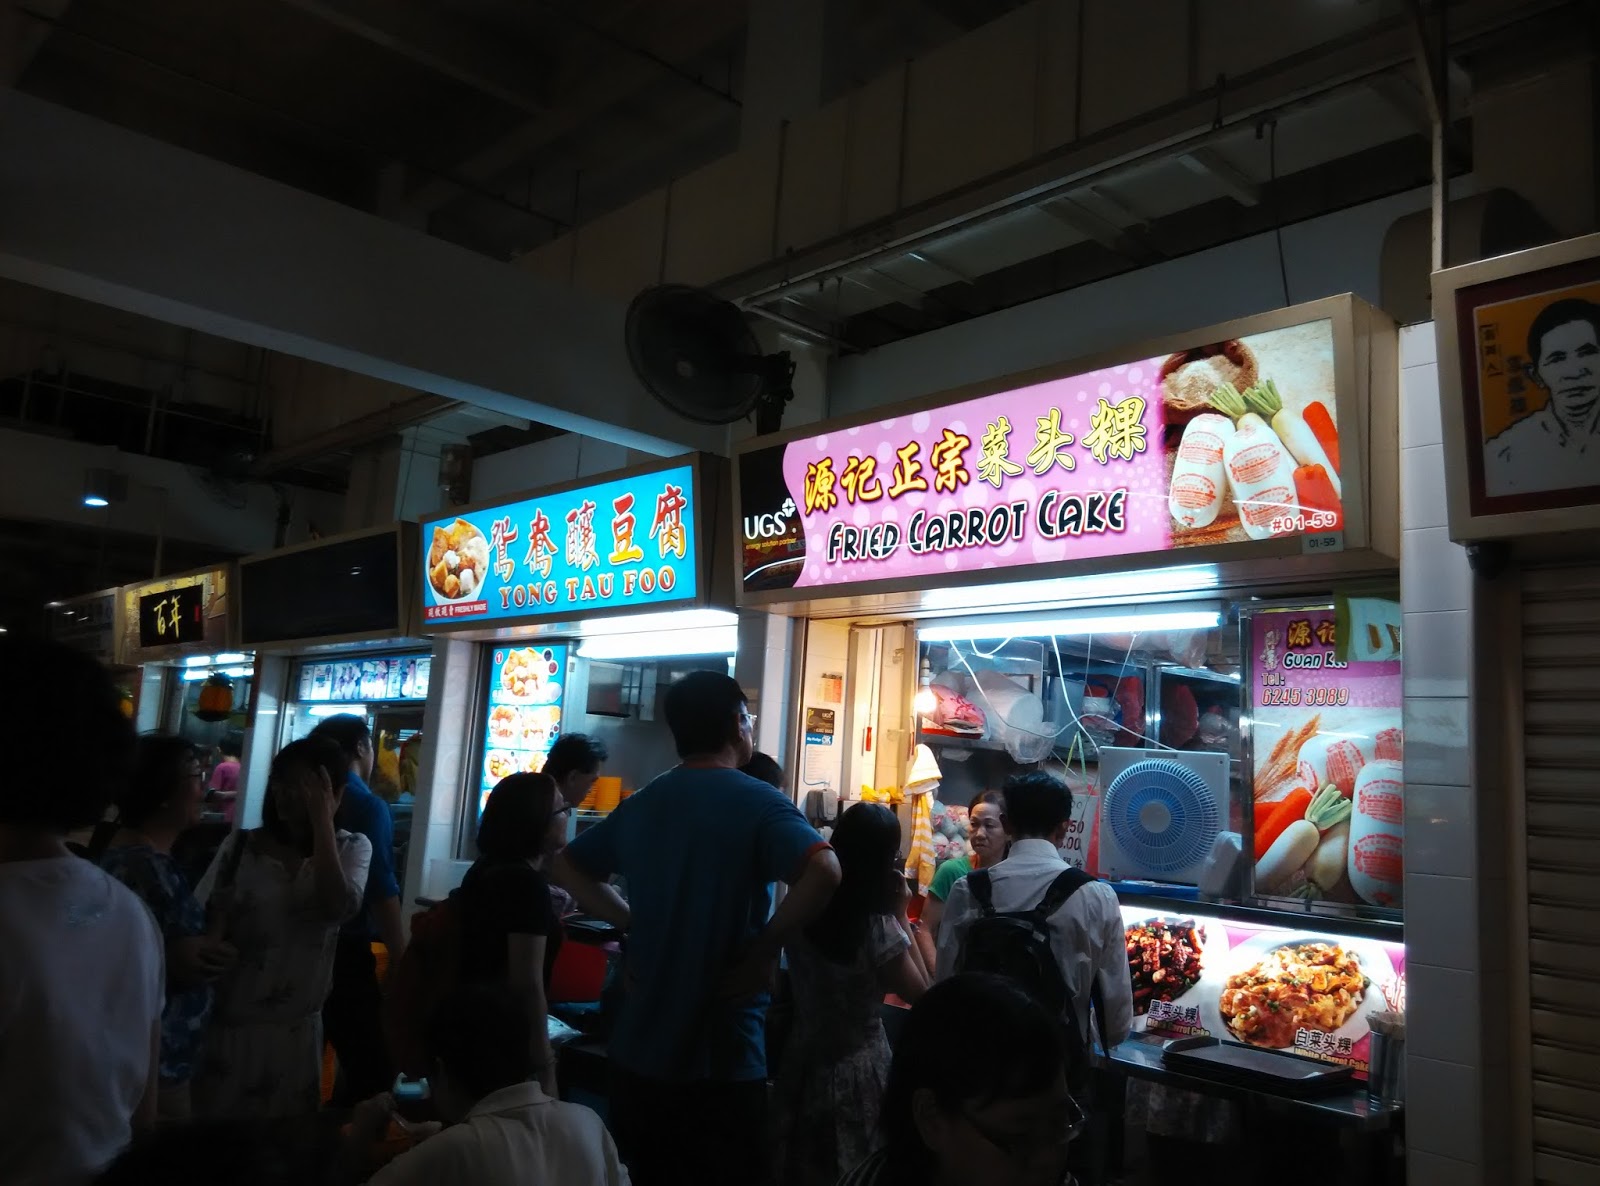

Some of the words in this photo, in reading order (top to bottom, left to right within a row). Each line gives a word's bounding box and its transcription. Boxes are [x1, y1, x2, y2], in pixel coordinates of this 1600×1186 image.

[804, 396, 1148, 516] 源记正宗菜头粿
[744, 511, 787, 540] UGS
[827, 521, 901, 563] FRIED
[908, 501, 1028, 554] CARROT
[1036, 488, 1127, 541] CAKE
[1270, 511, 1337, 533] #01-59
[1308, 537, 1336, 548] 01-59
[499, 581, 557, 608] YONG
[565, 573, 614, 601] TAU
[623, 565, 676, 595] FOO
[1261, 672, 1285, 686] Tel:
[1261, 688, 1301, 705] 6245
[1305, 688, 1349, 705] 3989
[1149, 999, 1198, 1023] 黑菜头粿
[1295, 1028, 1353, 1055] 白菜头粿
